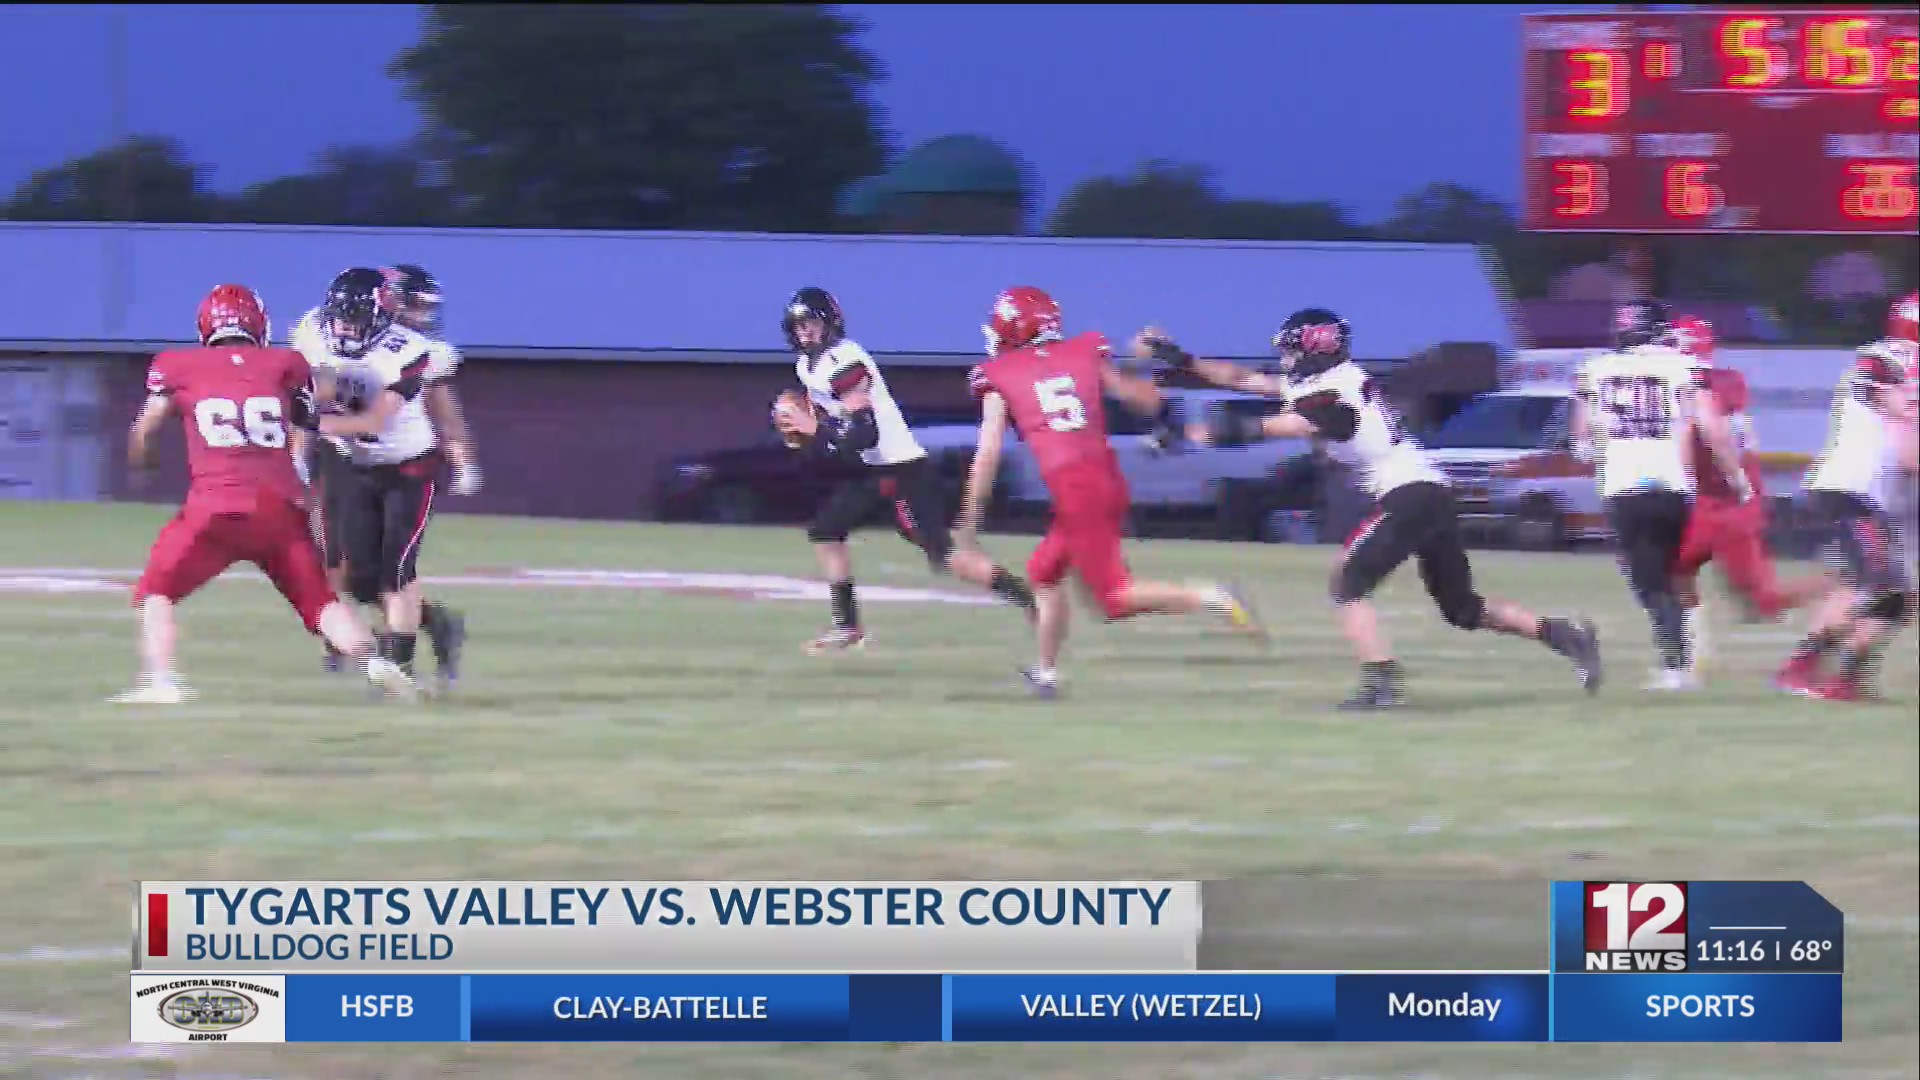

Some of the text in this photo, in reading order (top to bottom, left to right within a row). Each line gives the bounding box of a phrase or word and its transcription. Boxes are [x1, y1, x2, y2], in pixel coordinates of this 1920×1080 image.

[1568, 50, 1630, 118] 3
[1553, 163, 1608, 216] 3
[1663, 163, 1725, 218] 6
[195, 397, 287, 448] 66
[1033, 374, 1088, 432] 5
